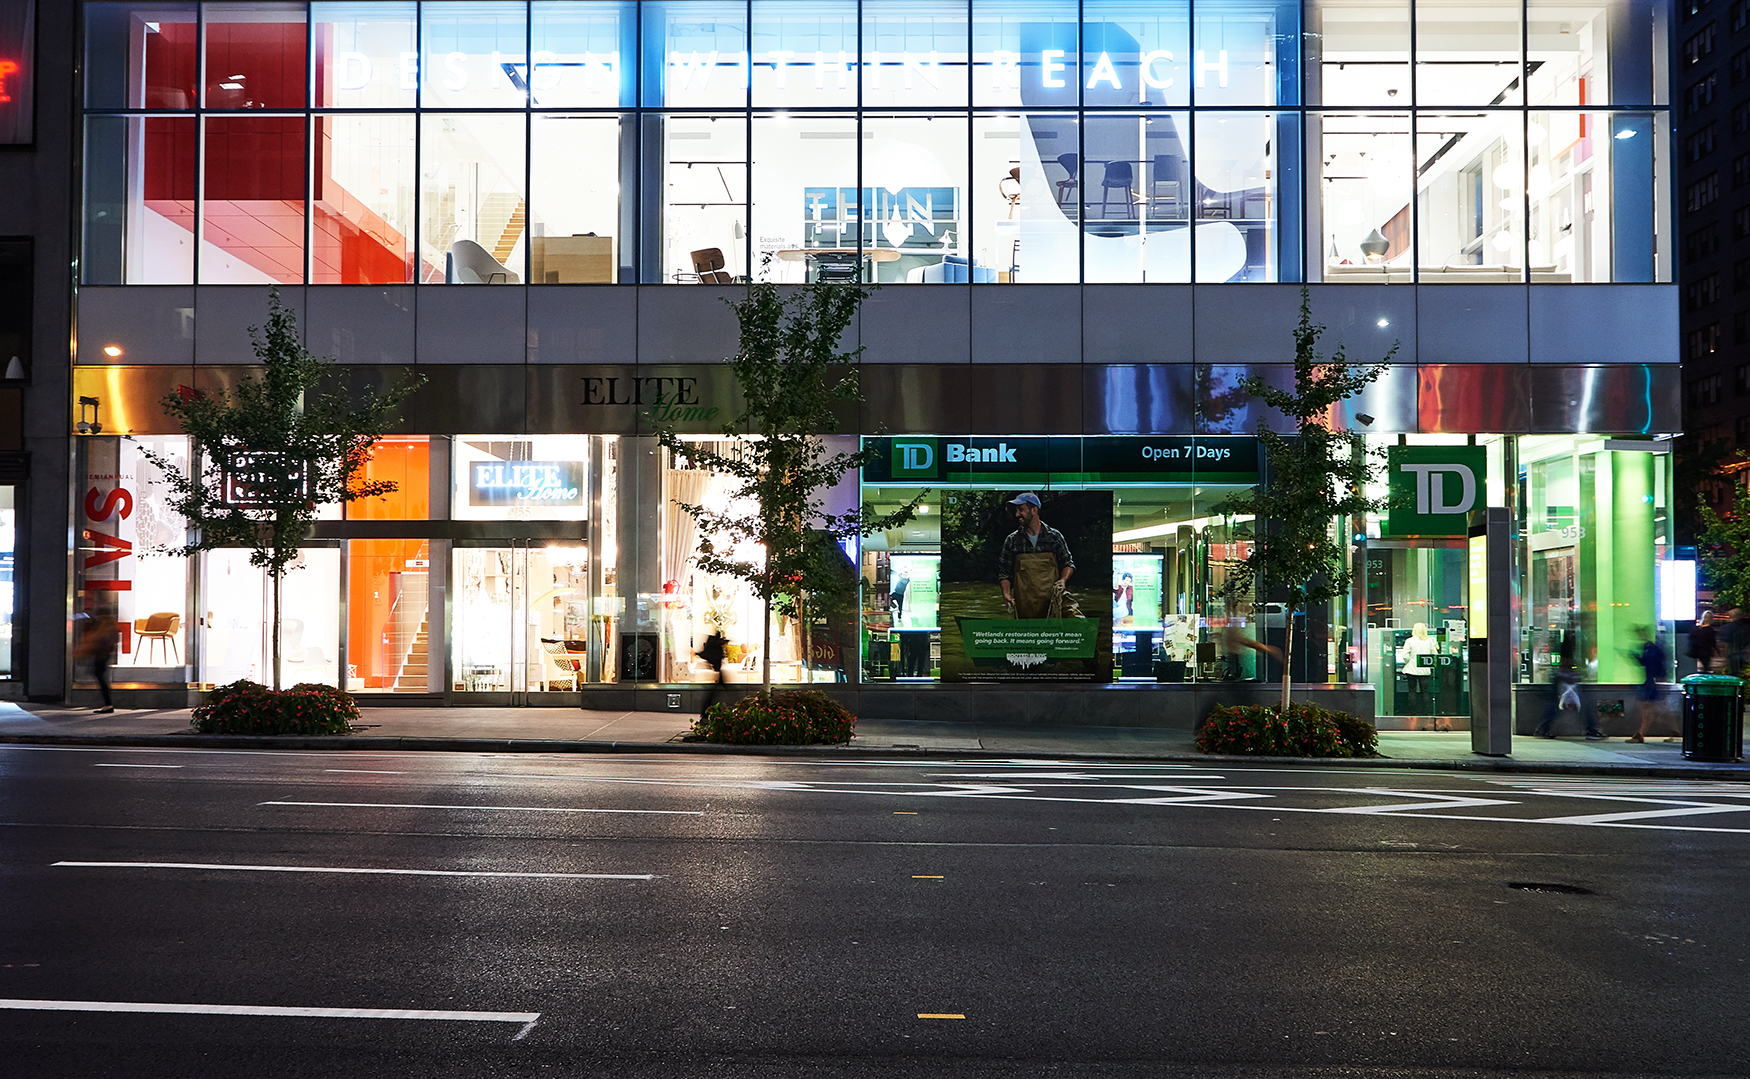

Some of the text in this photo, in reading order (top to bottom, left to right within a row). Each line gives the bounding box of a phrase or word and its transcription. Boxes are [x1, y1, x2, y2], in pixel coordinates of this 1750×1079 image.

[338, 48, 1229, 92] DESIGN WITHIN REACH
[580, 377, 699, 406] ELITE
[640, 387, 719, 422] Home
[895, 442, 1018, 470] TD Bank
[1141, 445, 1231, 461] Open 7 Days
[475, 465, 562, 488] ELITE
[516, 476, 579, 501] Home
[1400, 463, 1476, 515] TD
[1561, 526, 1587, 539] 953
[1366, 560, 1383, 569] 953
[1421, 656, 1434, 665] TD
[1438, 656, 1451, 665] TD
